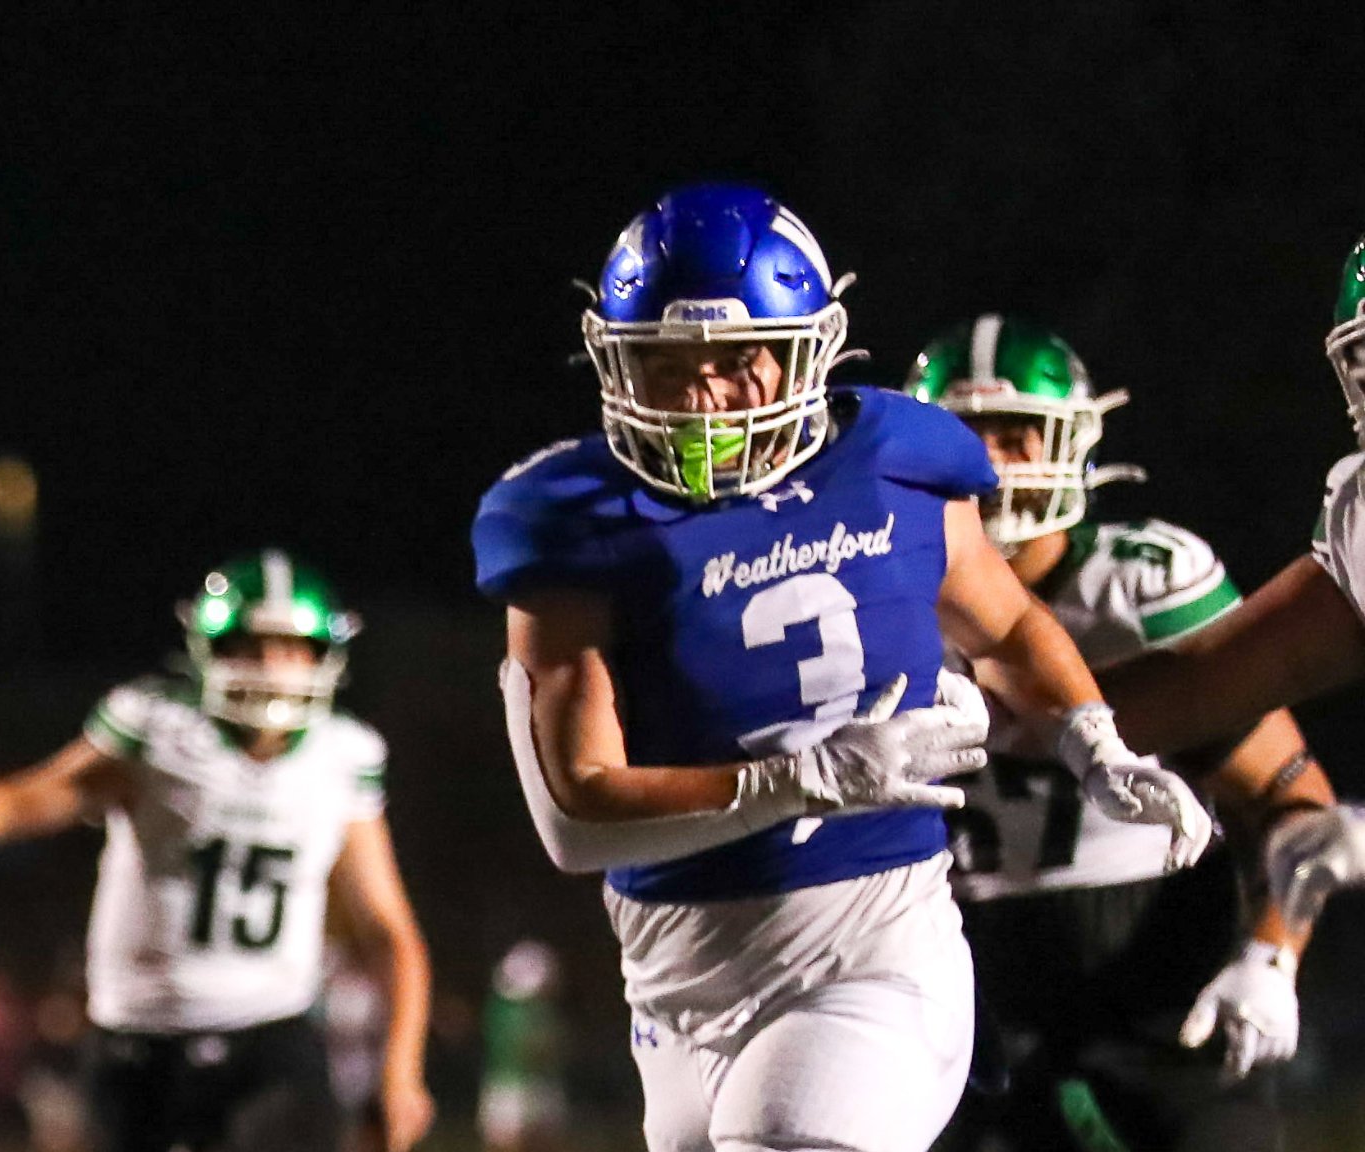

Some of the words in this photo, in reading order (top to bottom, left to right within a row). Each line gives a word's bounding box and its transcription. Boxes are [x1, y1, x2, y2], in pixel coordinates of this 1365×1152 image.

[702, 512, 895, 598] Weatherford
[736, 573, 866, 770] 3
[191, 836, 295, 949] 15
